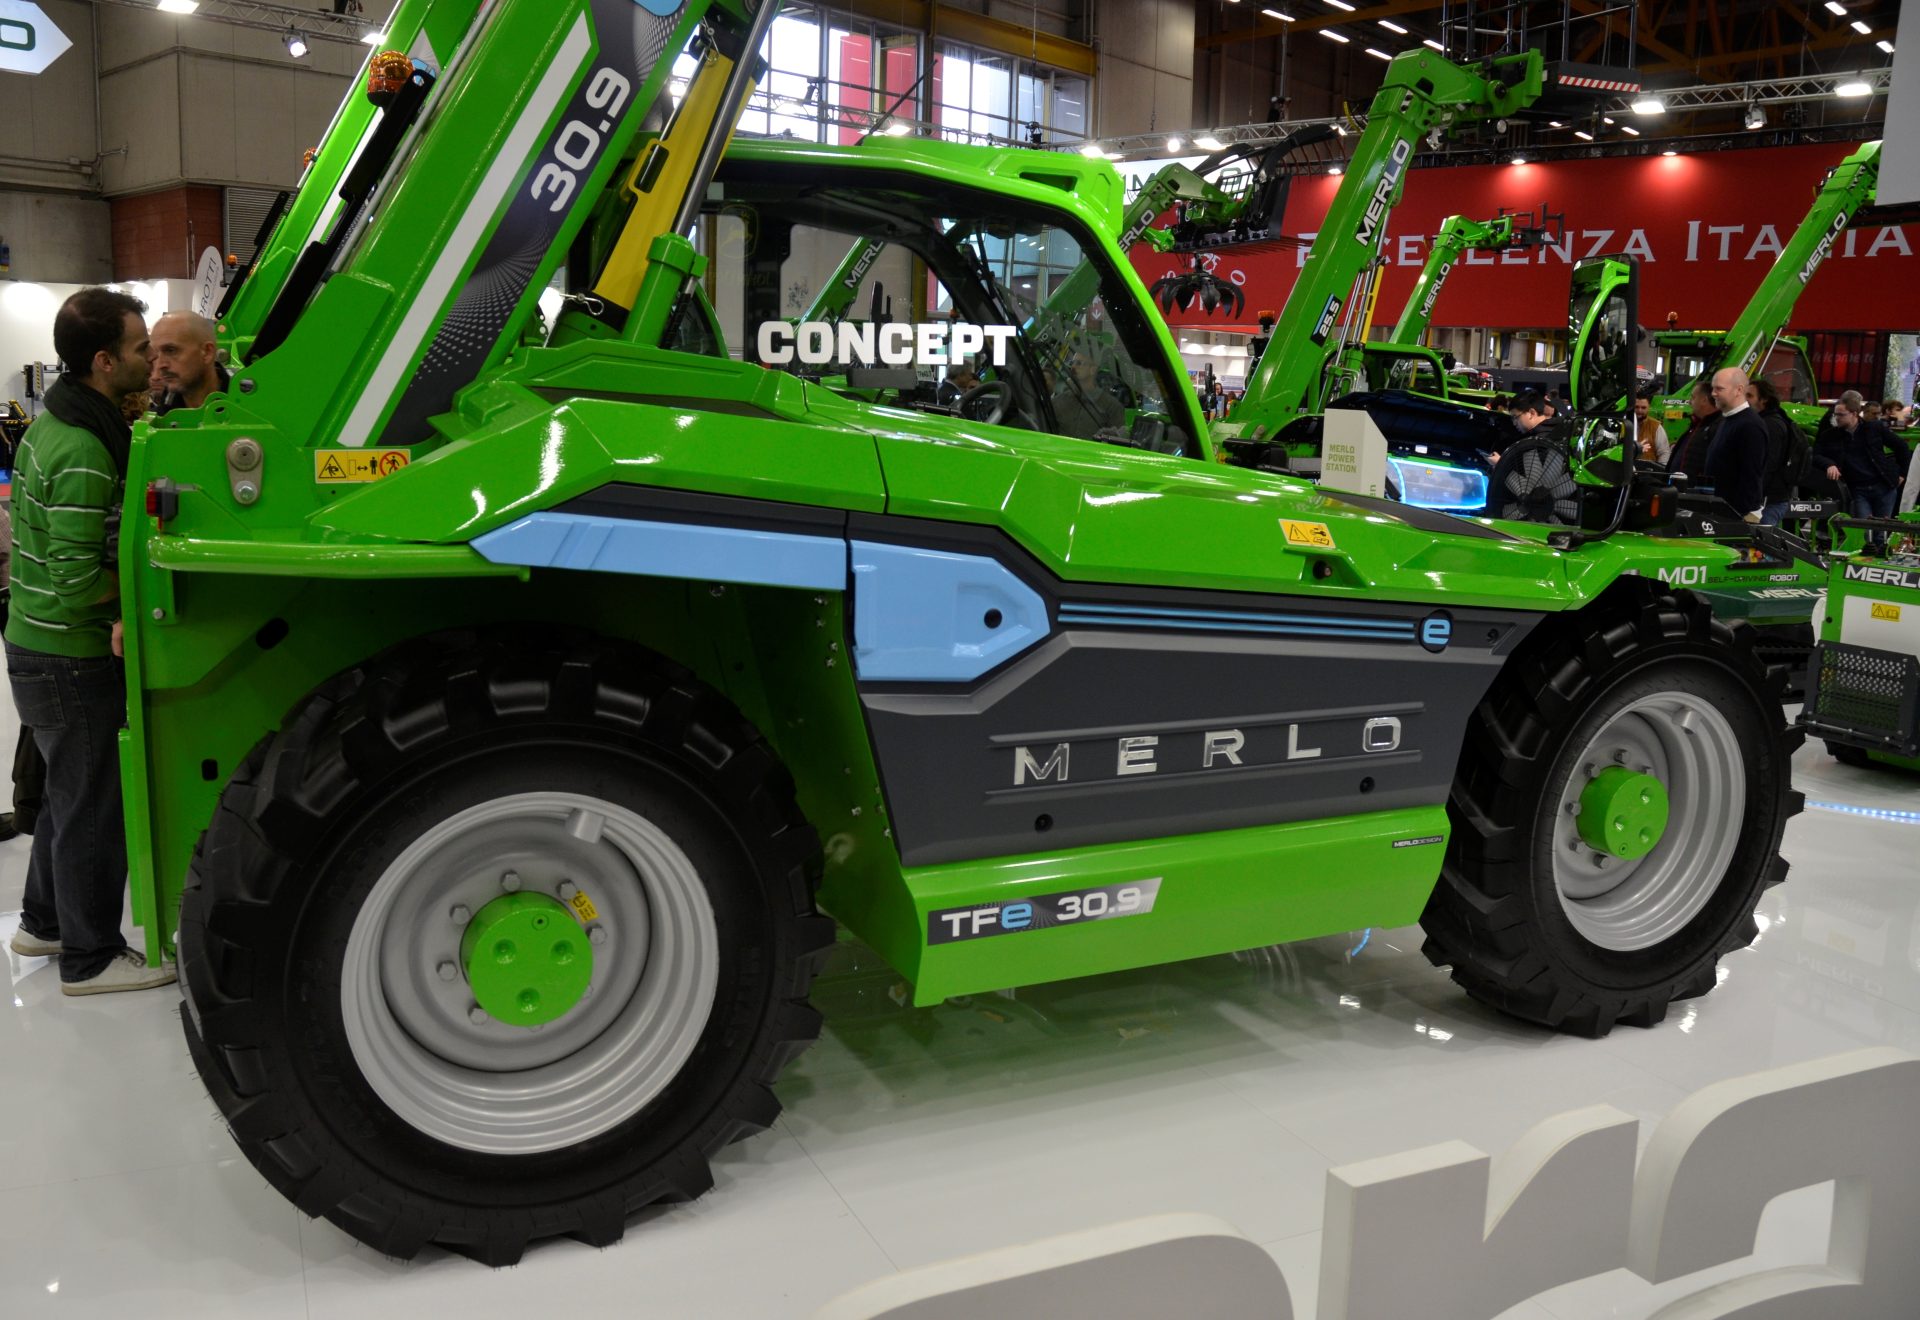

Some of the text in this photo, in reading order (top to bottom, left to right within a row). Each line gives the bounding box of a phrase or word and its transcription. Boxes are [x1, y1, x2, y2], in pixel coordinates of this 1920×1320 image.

[531, 67, 631, 212] 30.9
[1355, 139, 1411, 247] MERLO
[1118, 209, 1155, 252] ERLO
[1799, 211, 1847, 284] MERLO
[844, 240, 884, 288] MERL
[1420, 262, 1451, 318] MERLO
[1319, 300, 1340, 337] 25.5
[757, 320, 1017, 366] CONCEPT
[1326, 462, 1357, 473] STATION
[1328, 454, 1355, 464] POWER
[1329, 444, 1355, 454] MERLO
[1790, 503, 1822, 512] MERLO
[1769, 574, 1799, 582] ROBOT
[1845, 565, 1920, 589] MERL
[1014, 716, 1401, 786] MERLO
[941, 887, 1142, 938] TFe 30.9
